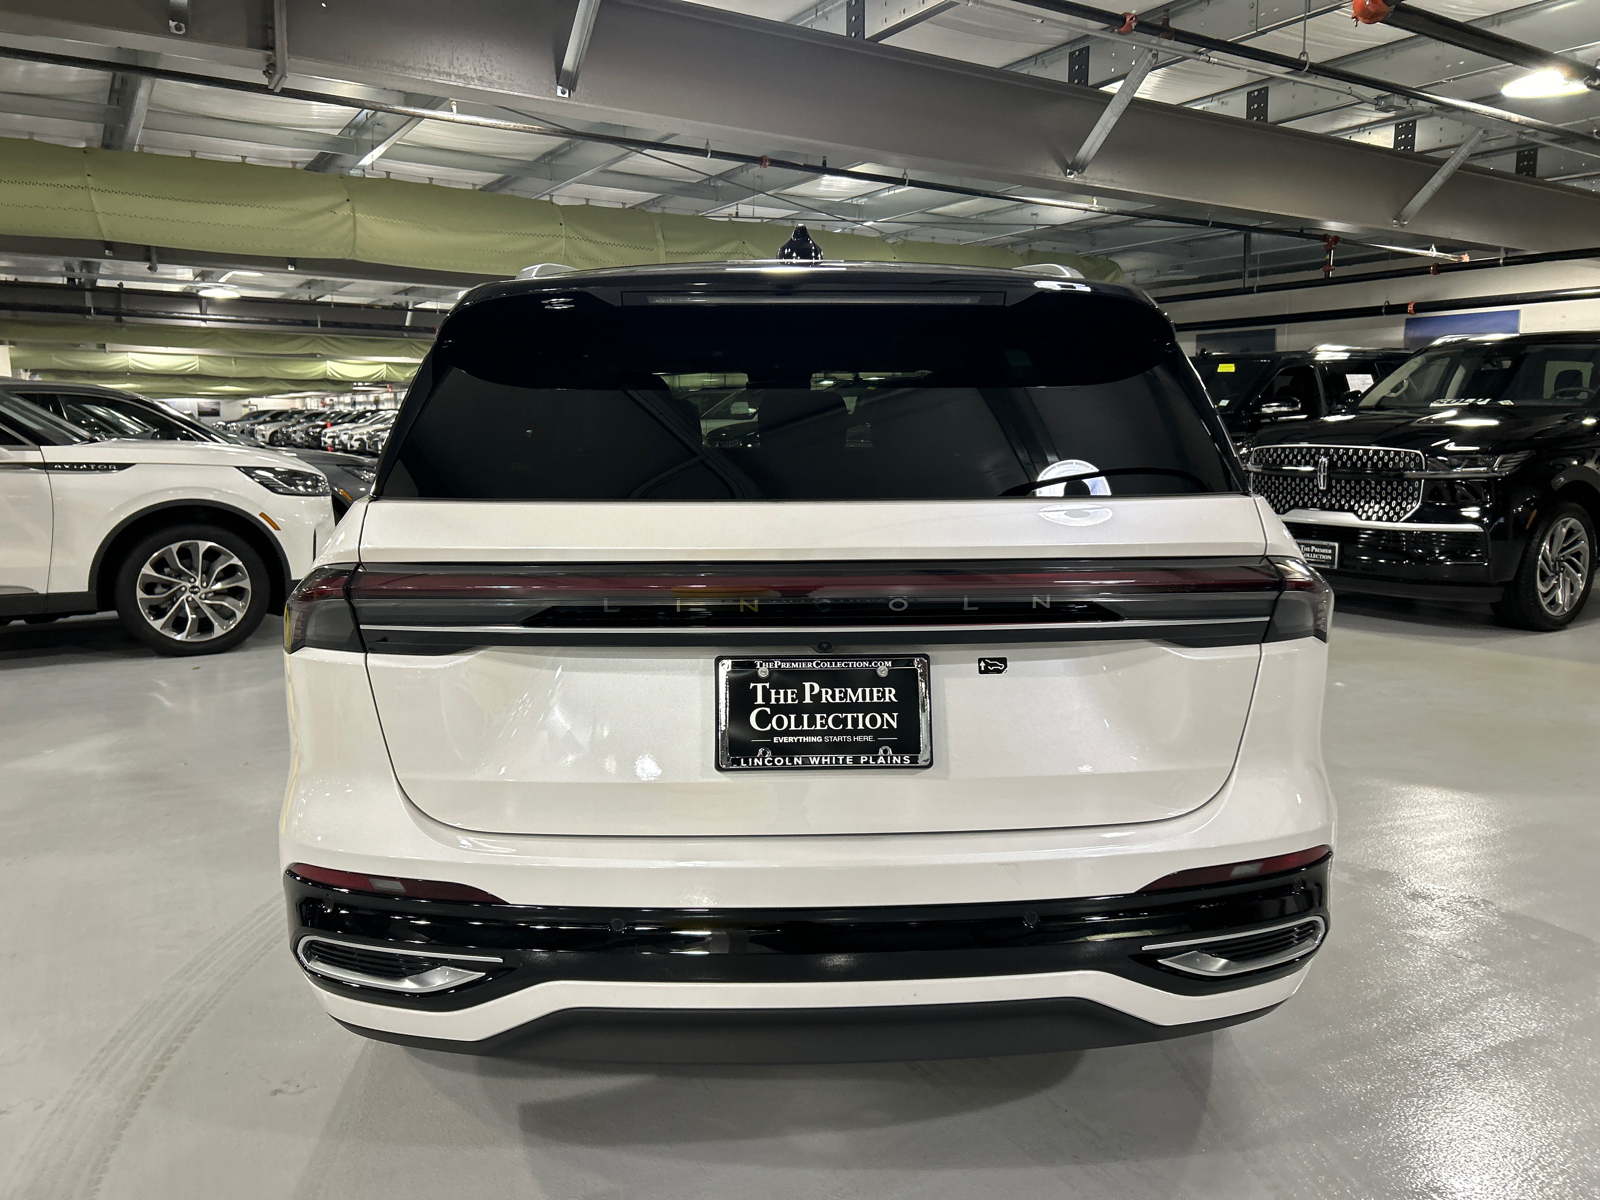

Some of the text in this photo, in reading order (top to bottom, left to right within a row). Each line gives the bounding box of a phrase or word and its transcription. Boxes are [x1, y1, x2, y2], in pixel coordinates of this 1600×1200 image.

[603, 594, 1051, 612] LINCOLN
[750, 681, 899, 705] THE PREMIER
[750, 707, 899, 732] COLLECTION
[773, 736, 823, 744] EVERYTHING
[824, 735, 852, 743] STARTS
[740, 755, 911, 767] LINCOLN WHITE PLAINS
